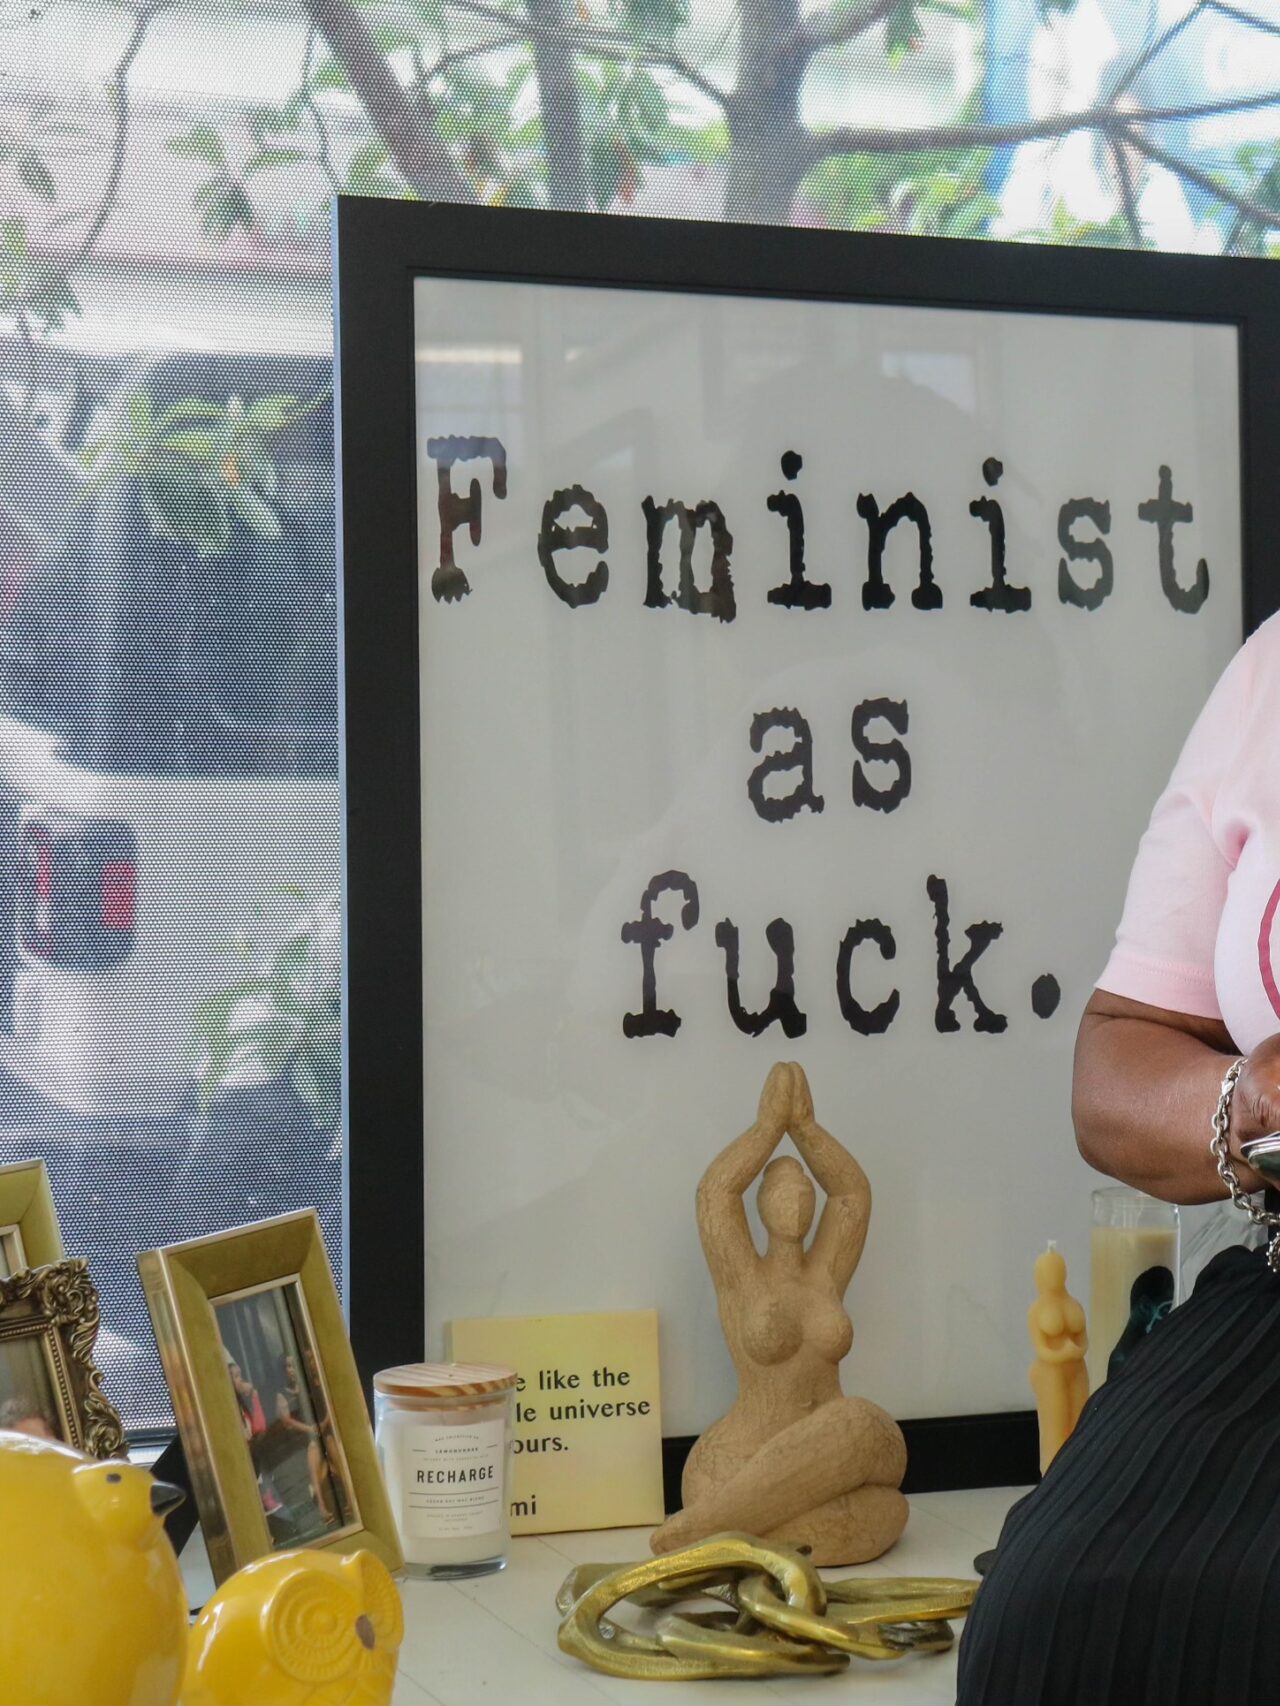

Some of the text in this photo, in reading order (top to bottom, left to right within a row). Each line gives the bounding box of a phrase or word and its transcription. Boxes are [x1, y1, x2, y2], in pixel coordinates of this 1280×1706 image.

[427, 435, 1211, 624] Feminist
[748, 697, 912, 824] as
[621, 870, 1062, 1040] fuck.
[539, 1369, 580, 1390] like
[593, 1367, 630, 1388] the
[550, 1399, 651, 1421] universe
[513, 1436, 569, 1454] ours.
[417, 1465, 494, 1483] RECHARGE
[511, 1495, 536, 1516] mi
